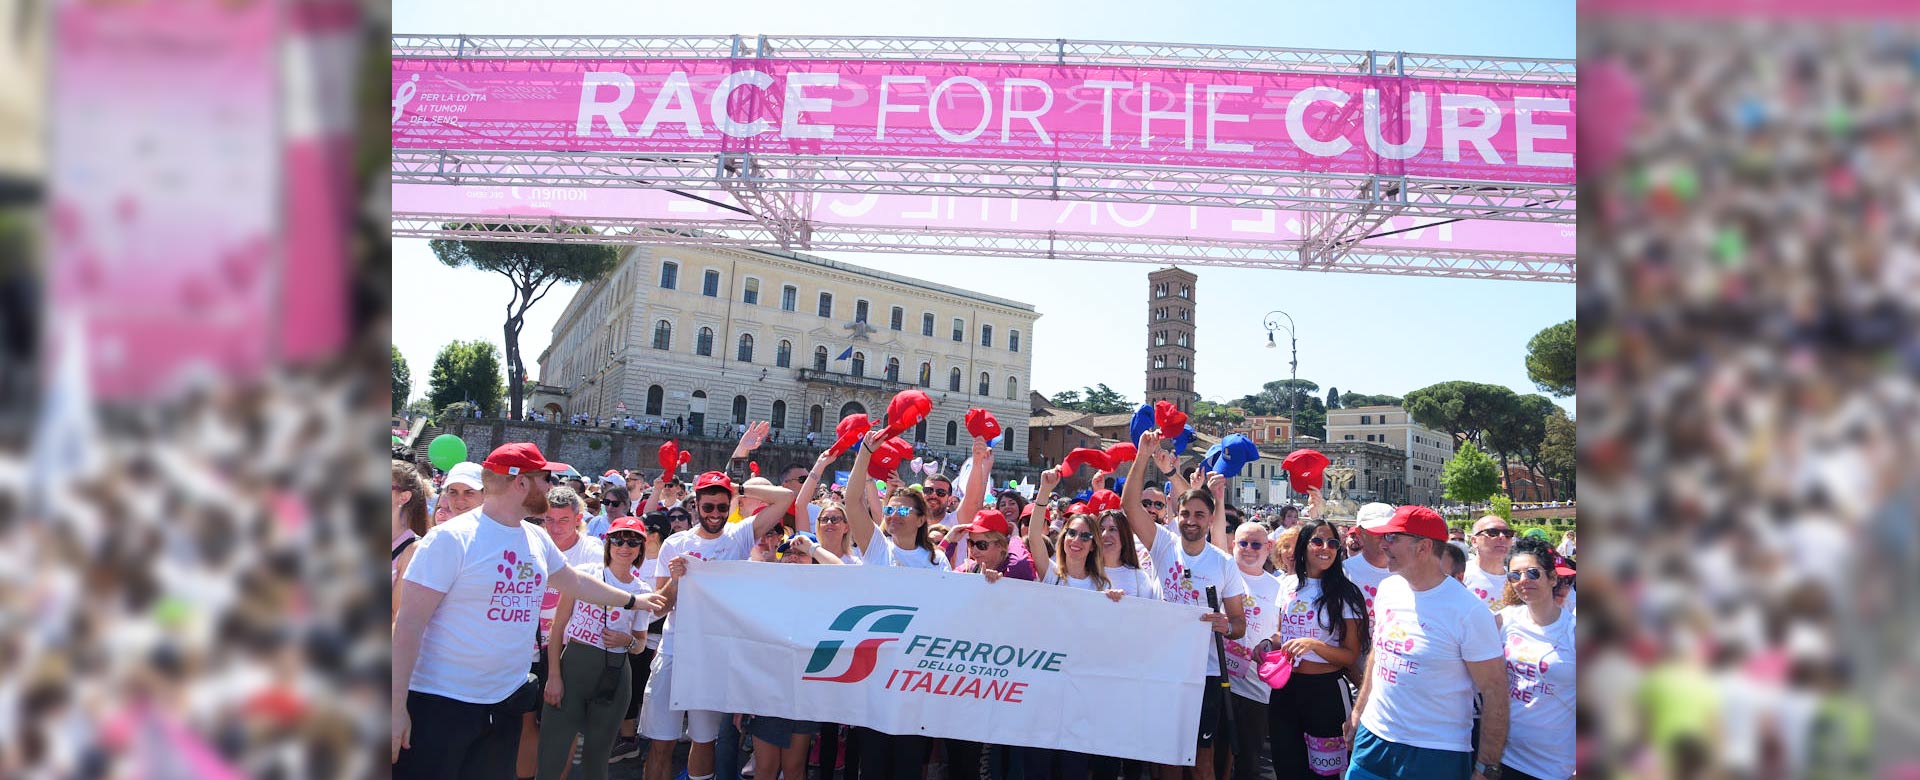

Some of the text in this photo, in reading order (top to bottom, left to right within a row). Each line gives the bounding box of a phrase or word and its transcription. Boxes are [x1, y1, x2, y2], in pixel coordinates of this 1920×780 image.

[420, 93, 487, 102] PER LA LOTTA
[416, 104, 467, 113] AI TUMORI
[410, 115, 458, 124] DEL SENO
[575, 70, 1574, 168] RACE FOR THE CURE
[516, 563, 534, 580] 25
[493, 581, 534, 594] RACE
[544, 586, 560, 595] URE
[489, 596, 521, 608] FOR
[1292, 600, 1309, 614] 25
[486, 607, 532, 623] CURE
[1282, 613, 1306, 626] ACE
[904, 634, 1067, 672] FERROVIE
[1375, 636, 1403, 657] ACE
[917, 659, 1009, 678] DELLO STATO
[1505, 660, 1537, 678] ACE
[885, 669, 1029, 704] ITALIANE
